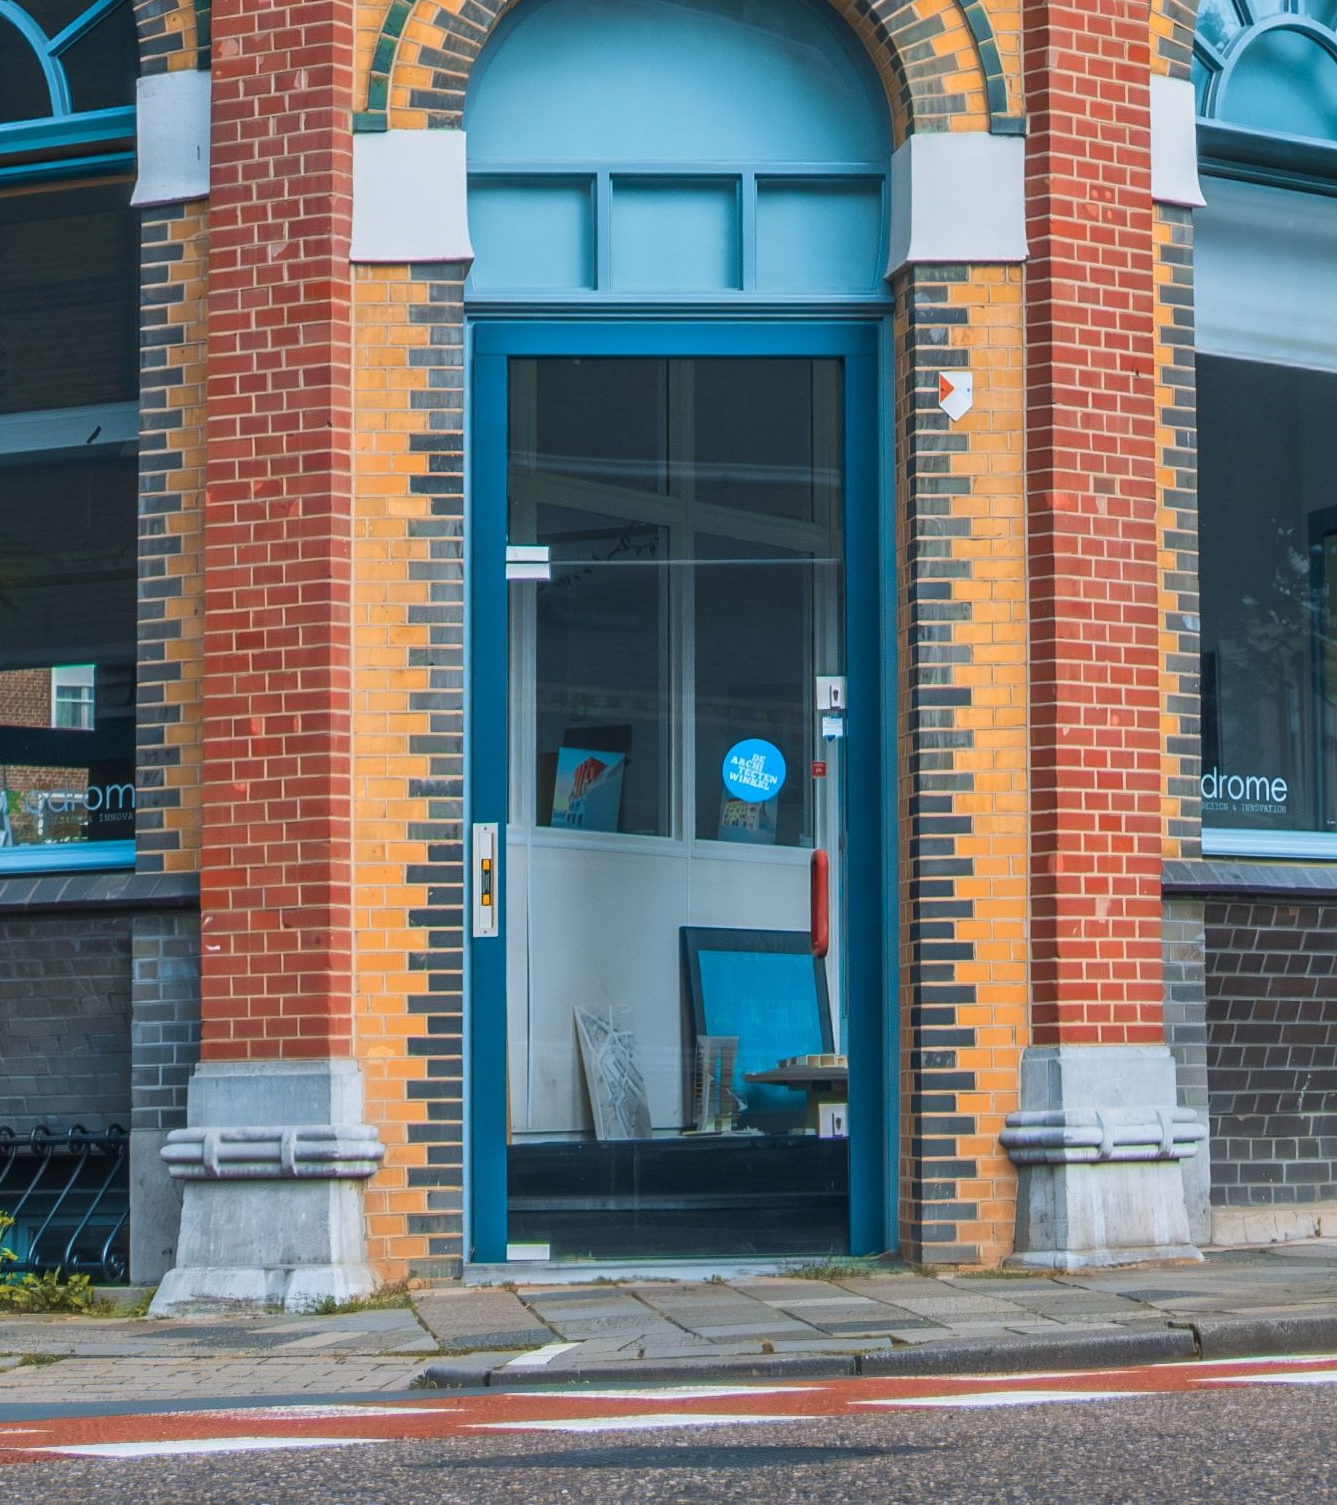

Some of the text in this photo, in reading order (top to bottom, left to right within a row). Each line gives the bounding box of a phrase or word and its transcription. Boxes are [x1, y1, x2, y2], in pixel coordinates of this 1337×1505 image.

[730, 755, 764, 772] ARCHI
[752, 753, 766, 763] DE
[729, 772, 770, 791] WINKEL
[738, 765, 778, 785] TECTEN
[1200, 766, 1288, 802] drome
